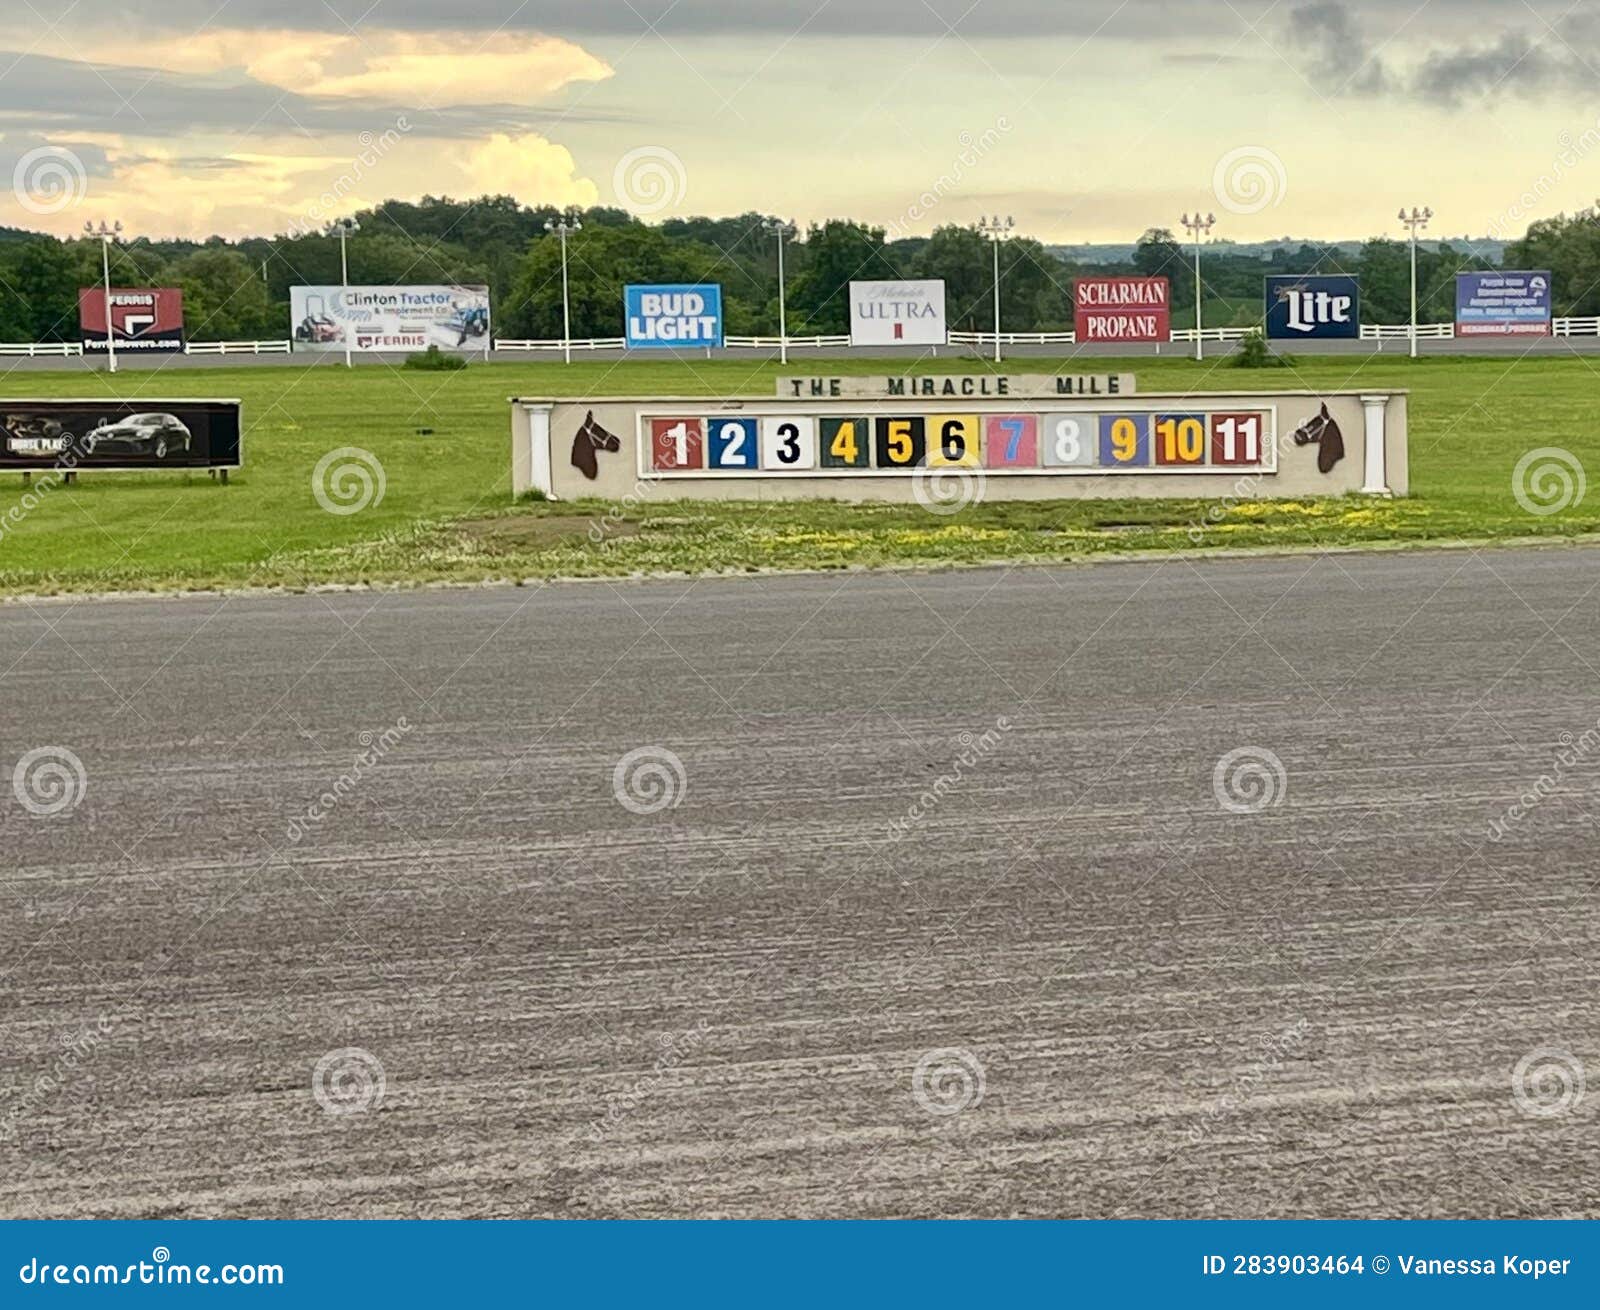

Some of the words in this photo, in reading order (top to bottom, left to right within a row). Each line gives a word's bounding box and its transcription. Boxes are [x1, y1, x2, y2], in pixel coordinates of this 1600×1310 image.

[109, 295, 153, 305] FERRIS
[346, 293, 397, 305] Clinton
[400, 293, 450, 305] Tractor
[1079, 283, 1164, 304] SCHARMAN
[641, 293, 704, 317] BUD
[858, 302, 936, 319] ULTRA
[1286, 290, 1351, 332] Lite
[630, 316, 717, 340] LIGHT
[1087, 316, 1157, 337] PROPANE
[84, 339, 181, 349] FerriMowers.com
[375, 336, 425, 346] FERRIS
[791, 378, 840, 396] THE
[888, 377, 1008, 396] MIRACLE
[1056, 376, 1119, 394] MILE
[667, 422, 687, 465] 1
[719, 423, 746, 465] 2
[776, 423, 801, 463] 3
[830, 422, 858, 463] 4
[887, 422, 913, 463] 5
[940, 421, 965, 461] 6
[1000, 421, 1024, 461] 7
[1055, 420, 1080, 461] 8
[1111, 418, 1137, 461] 9
[1157, 419, 1203, 461] 10
[1216, 418, 1257, 460] 11
